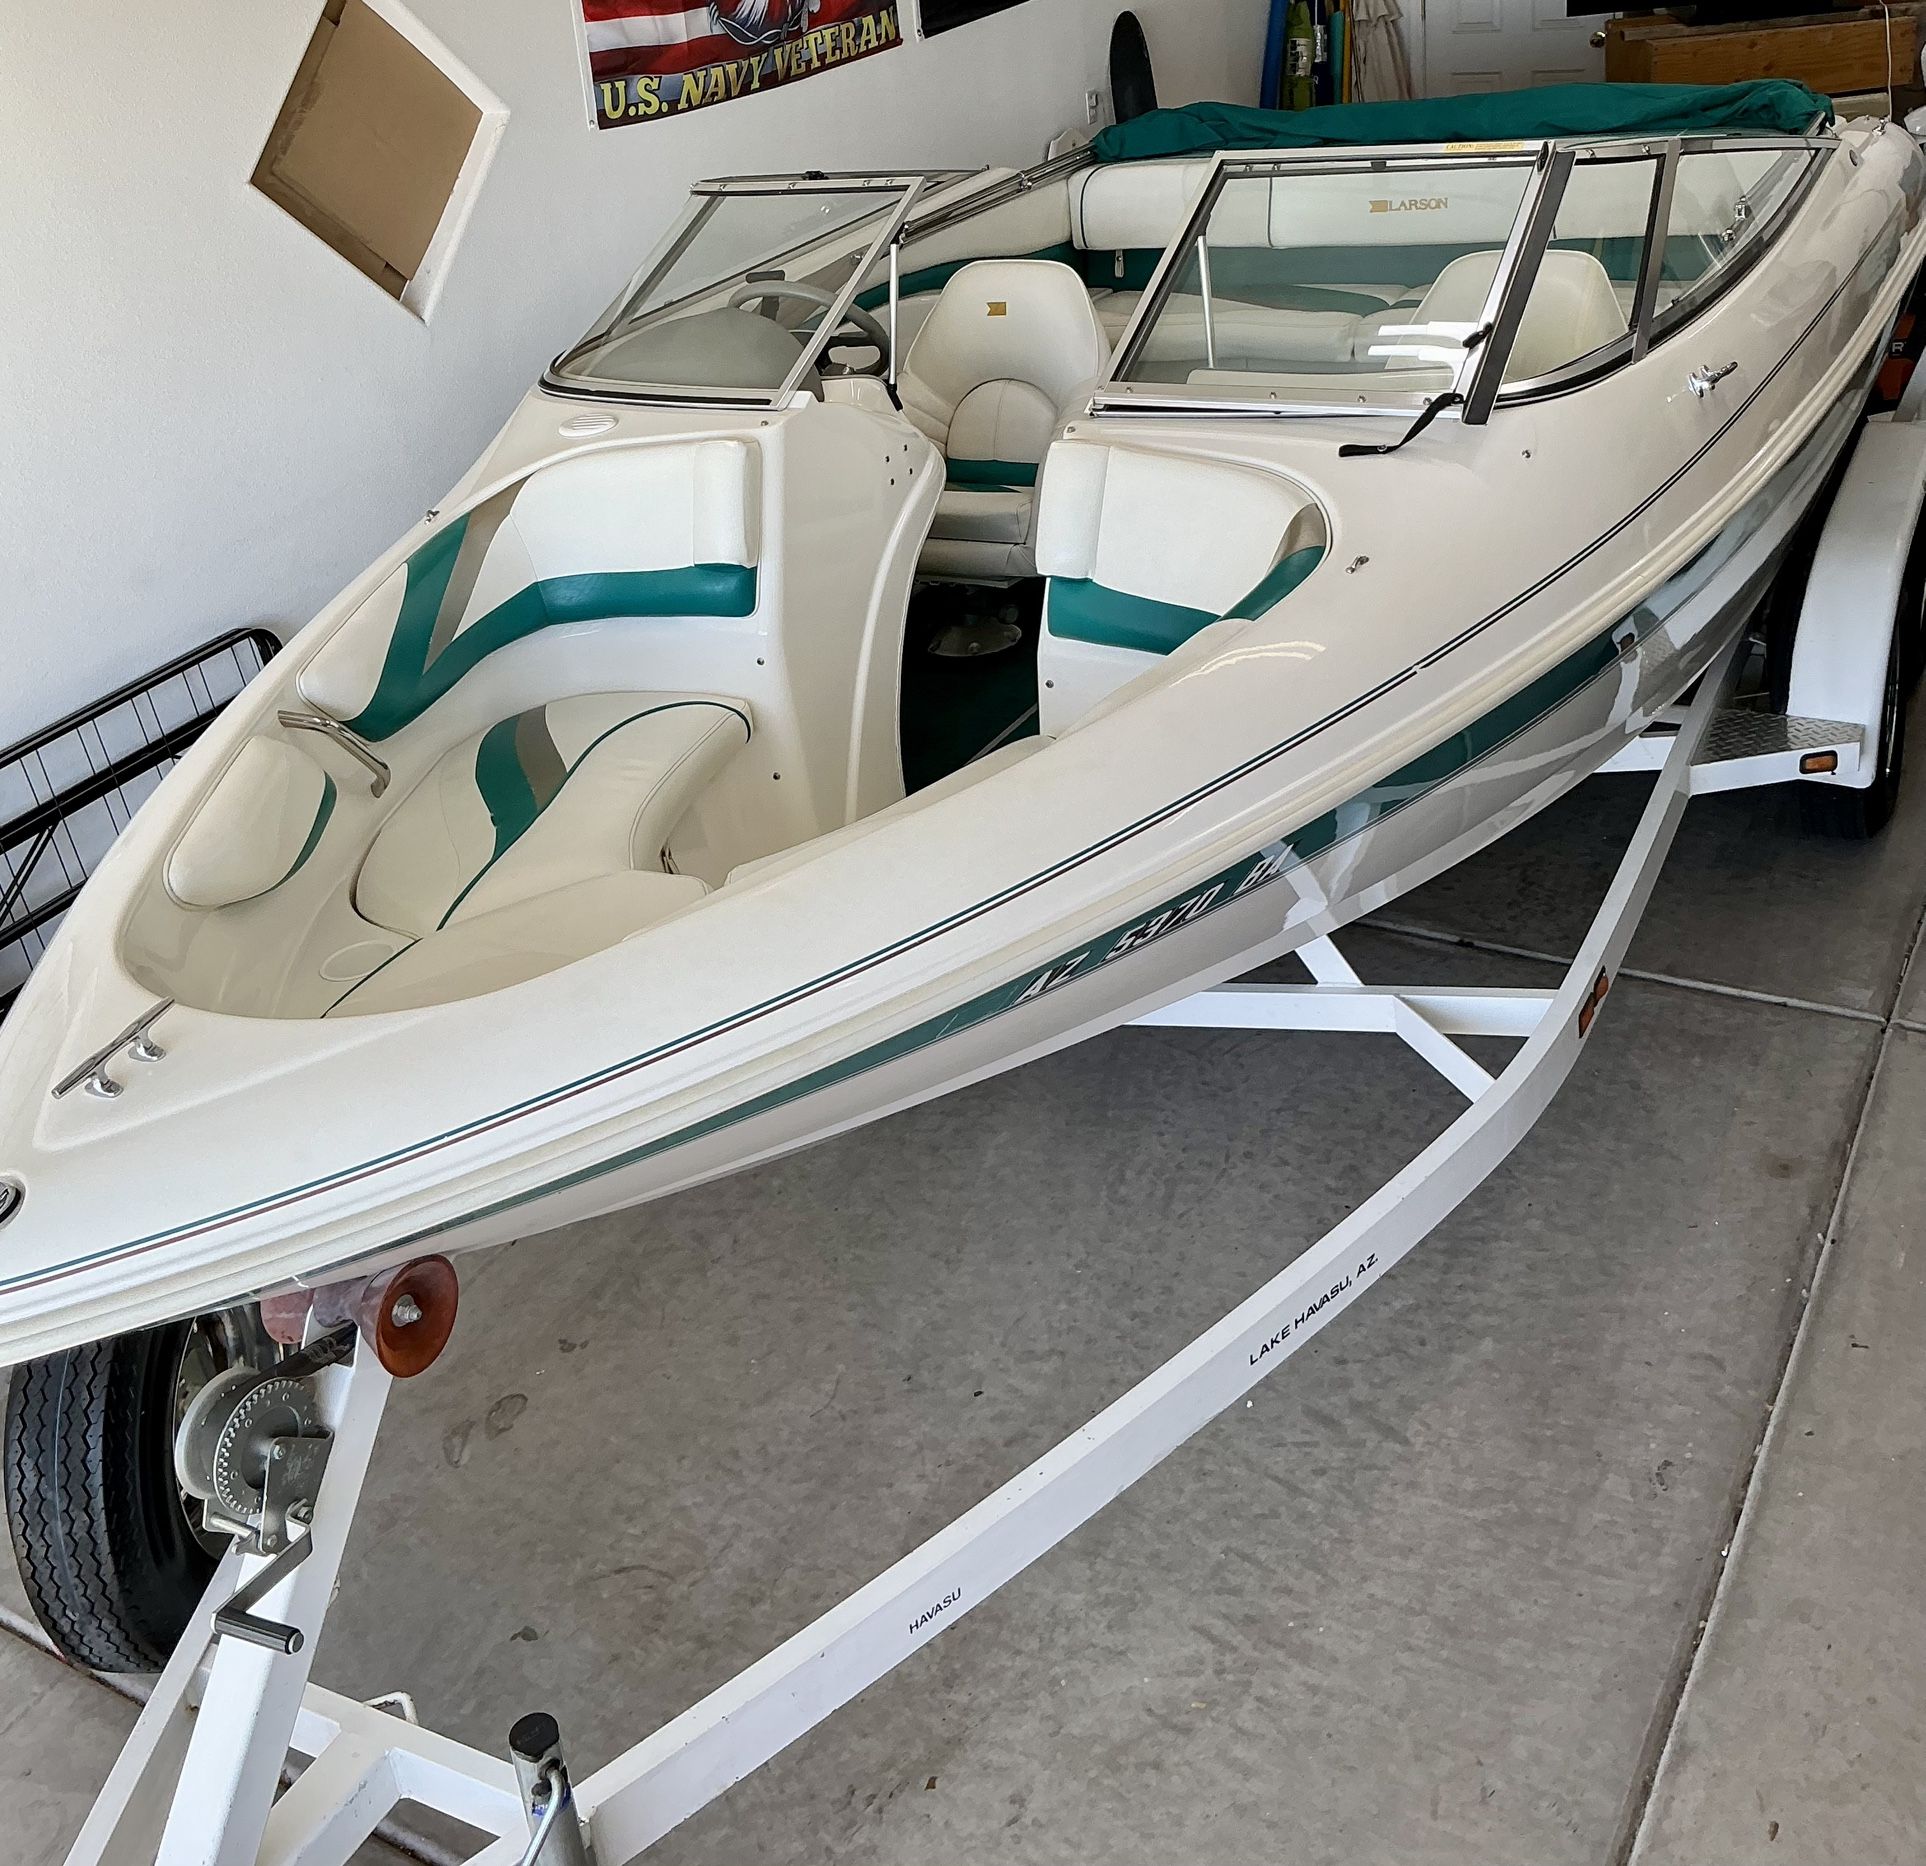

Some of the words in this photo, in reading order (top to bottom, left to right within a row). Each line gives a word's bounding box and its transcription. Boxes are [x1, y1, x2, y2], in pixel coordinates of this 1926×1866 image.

[600, 76, 668, 119] U.S.
[678, 53, 768, 110] NAVY
[774, 9, 897, 81] VETERAN
[1388, 198, 1448, 211] LARSON
[1013, 950, 1091, 1004] AZ
[1104, 882, 1225, 960] 5370
[1233, 843, 1295, 895] BA
[1249, 1324, 1291, 1366] LAKE
[1294, 1275, 1352, 1329] HAVASU,
[1356, 1253, 1379, 1278] AZ.
[909, 1587, 961, 1634] HAVASU
